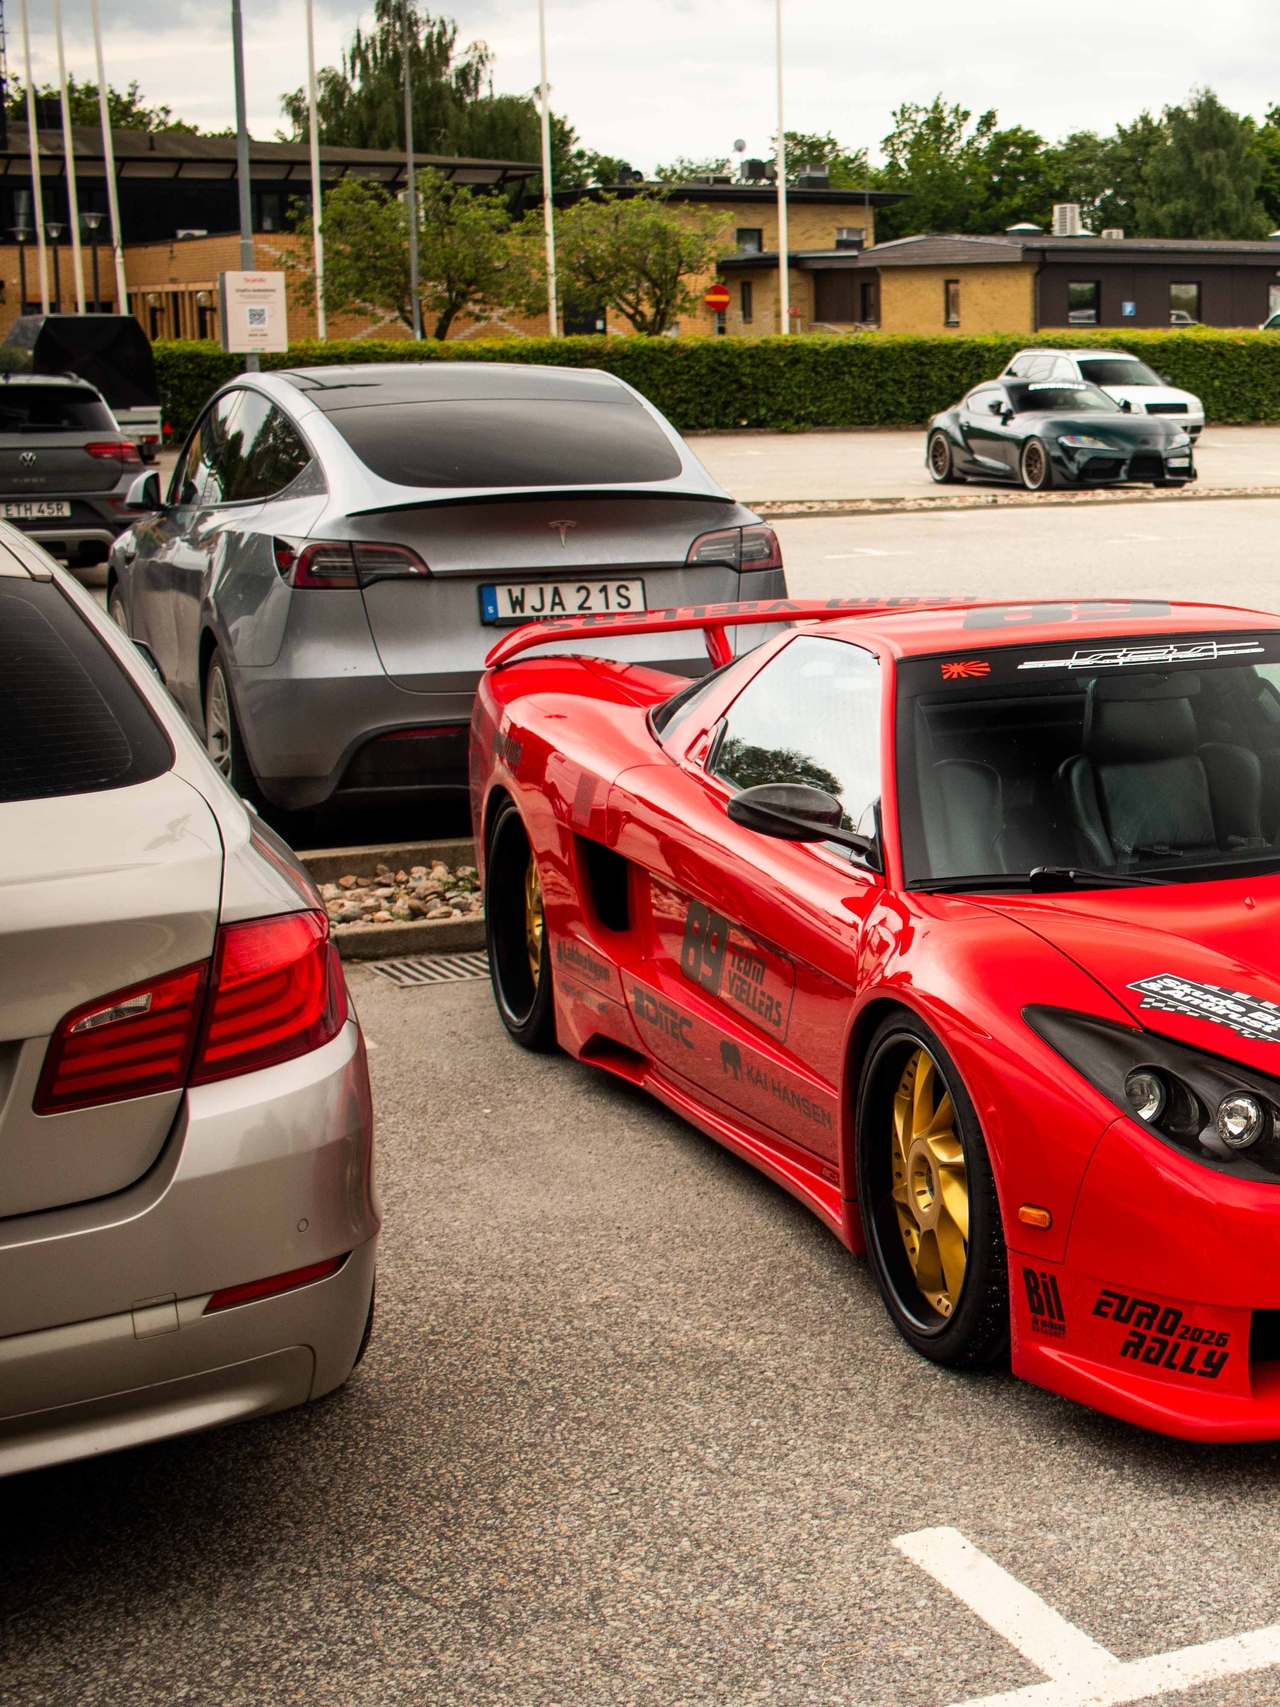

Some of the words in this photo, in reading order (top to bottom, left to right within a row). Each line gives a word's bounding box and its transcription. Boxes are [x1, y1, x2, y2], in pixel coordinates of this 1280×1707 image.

[5, 503, 33, 515] ETH
[37, 501, 65, 515] 45R
[508, 586, 566, 614] WJA
[576, 584, 631, 611] 21S
[681, 899, 730, 997] 89
[731, 942, 766, 985] TEAM
[1157, 978, 1246, 1013] Skude
[746, 1063, 768, 1091] KAI
[772, 1078, 832, 1131] HANSEN
[1022, 1266, 1065, 1322] Bil
[1092, 1288, 1183, 1336] EURO
[1177, 1324, 1230, 1348] 2026
[1119, 1330, 1230, 1379] RALLY
